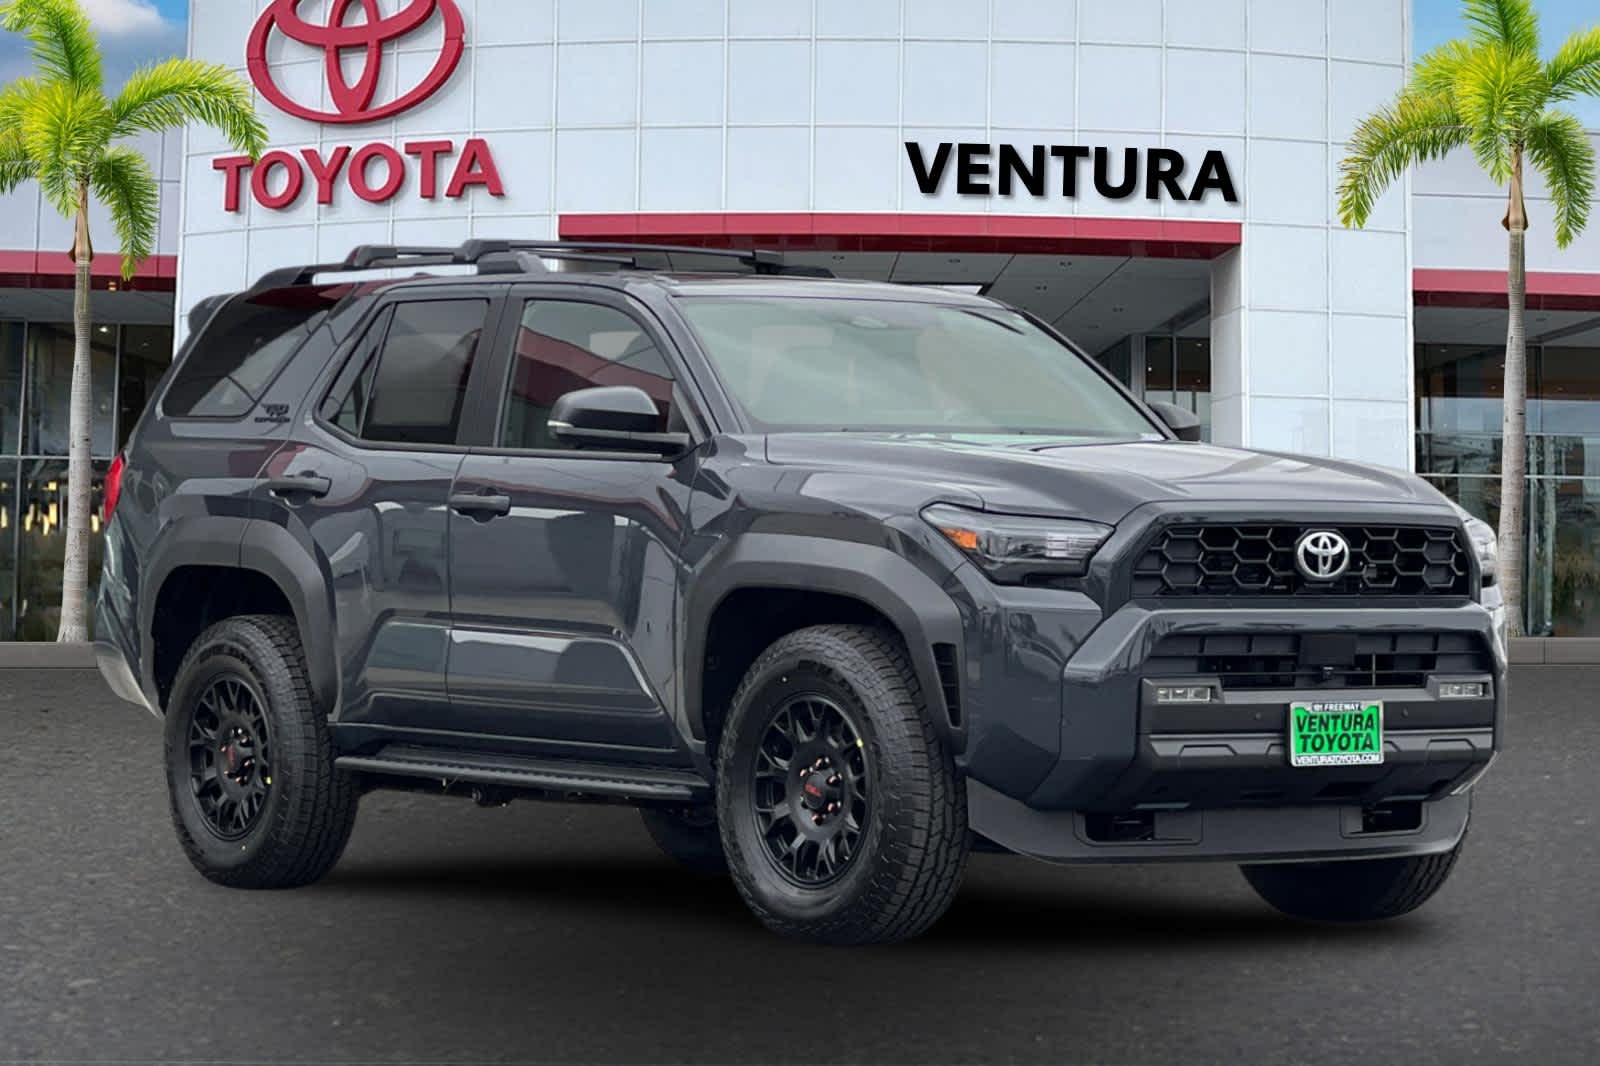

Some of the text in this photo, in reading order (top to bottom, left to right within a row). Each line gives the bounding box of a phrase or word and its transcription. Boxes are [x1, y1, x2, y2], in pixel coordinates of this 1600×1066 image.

[213, 139, 505, 212] TOYOTA
[905, 142, 1239, 203] VENTURA
[1296, 713, 1375, 732] VENTURA
[1300, 733, 1374, 752] TOYOTA
